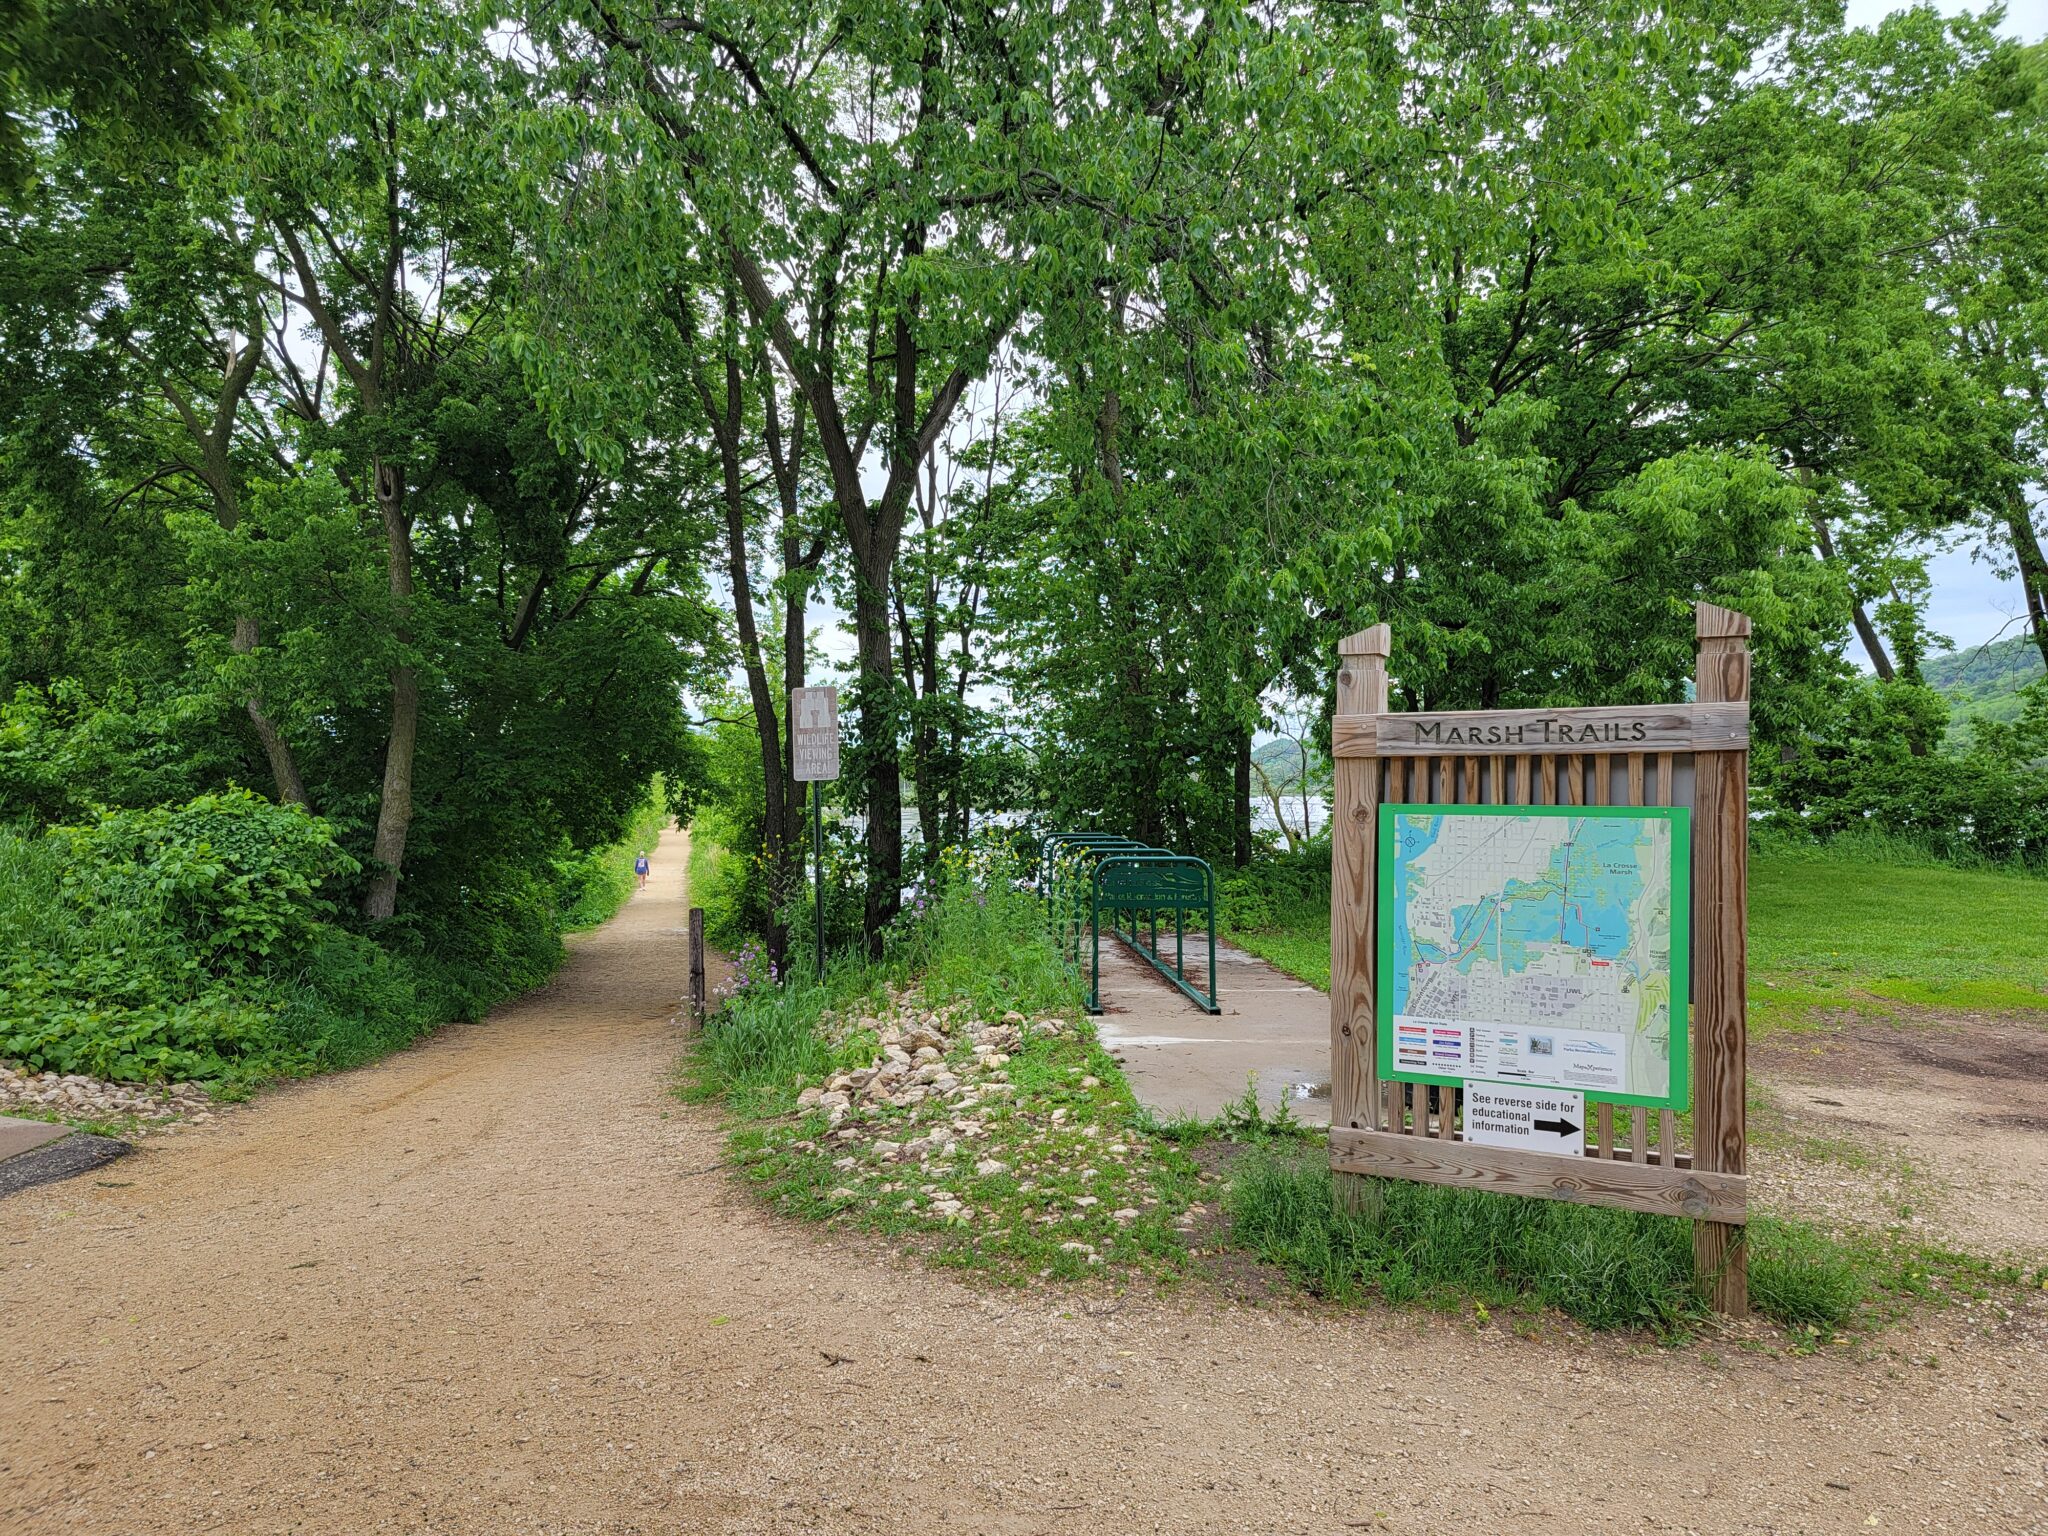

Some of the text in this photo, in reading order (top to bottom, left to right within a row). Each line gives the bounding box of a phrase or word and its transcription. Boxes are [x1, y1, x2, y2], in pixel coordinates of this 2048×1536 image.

[797, 733, 835, 745] WILDLIFE
[800, 747, 832, 760] VIEWING
[806, 762, 828, 774] AREA
[1472, 1092, 1575, 1113] See reverse side for
[1472, 1107, 1530, 1122] educational
[1472, 1119, 1529, 1135] information
